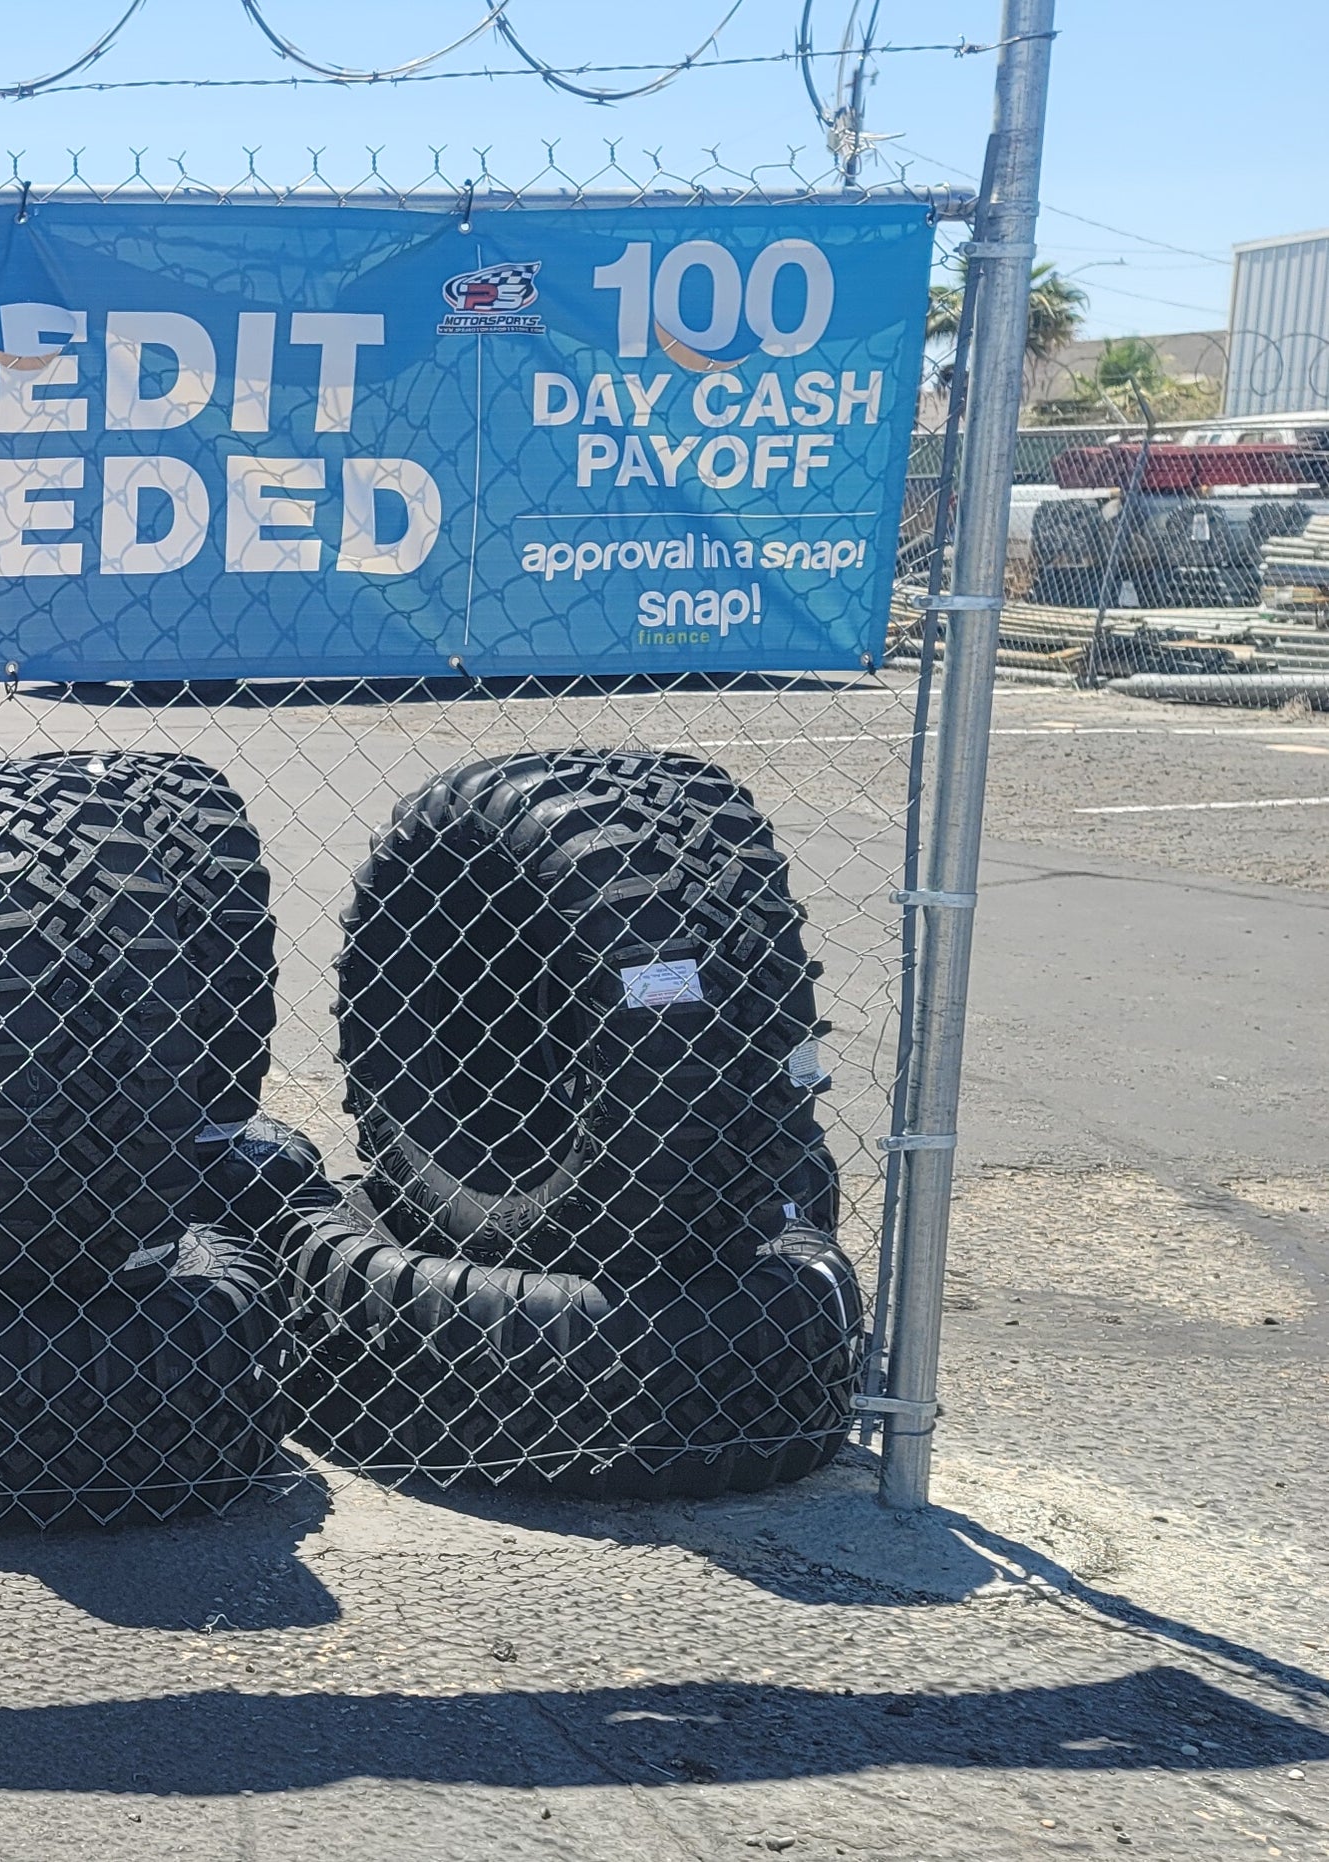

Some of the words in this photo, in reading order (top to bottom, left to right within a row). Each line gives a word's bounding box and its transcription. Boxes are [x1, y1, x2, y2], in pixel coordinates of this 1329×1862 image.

[444, 316, 539, 326] MOTORSPORTS
[593, 238, 836, 360] 100
[532, 371, 674, 427] DAY
[692, 370, 884, 427] CASH
[576, 433, 835, 489] PAYOFF
[521, 532, 693, 581] approval
[702, 533, 732, 568] in
[735, 541, 754, 568] a
[760, 538, 867, 578] snap!
[637, 582, 761, 637] snap!
[638, 628, 711, 646] finance
